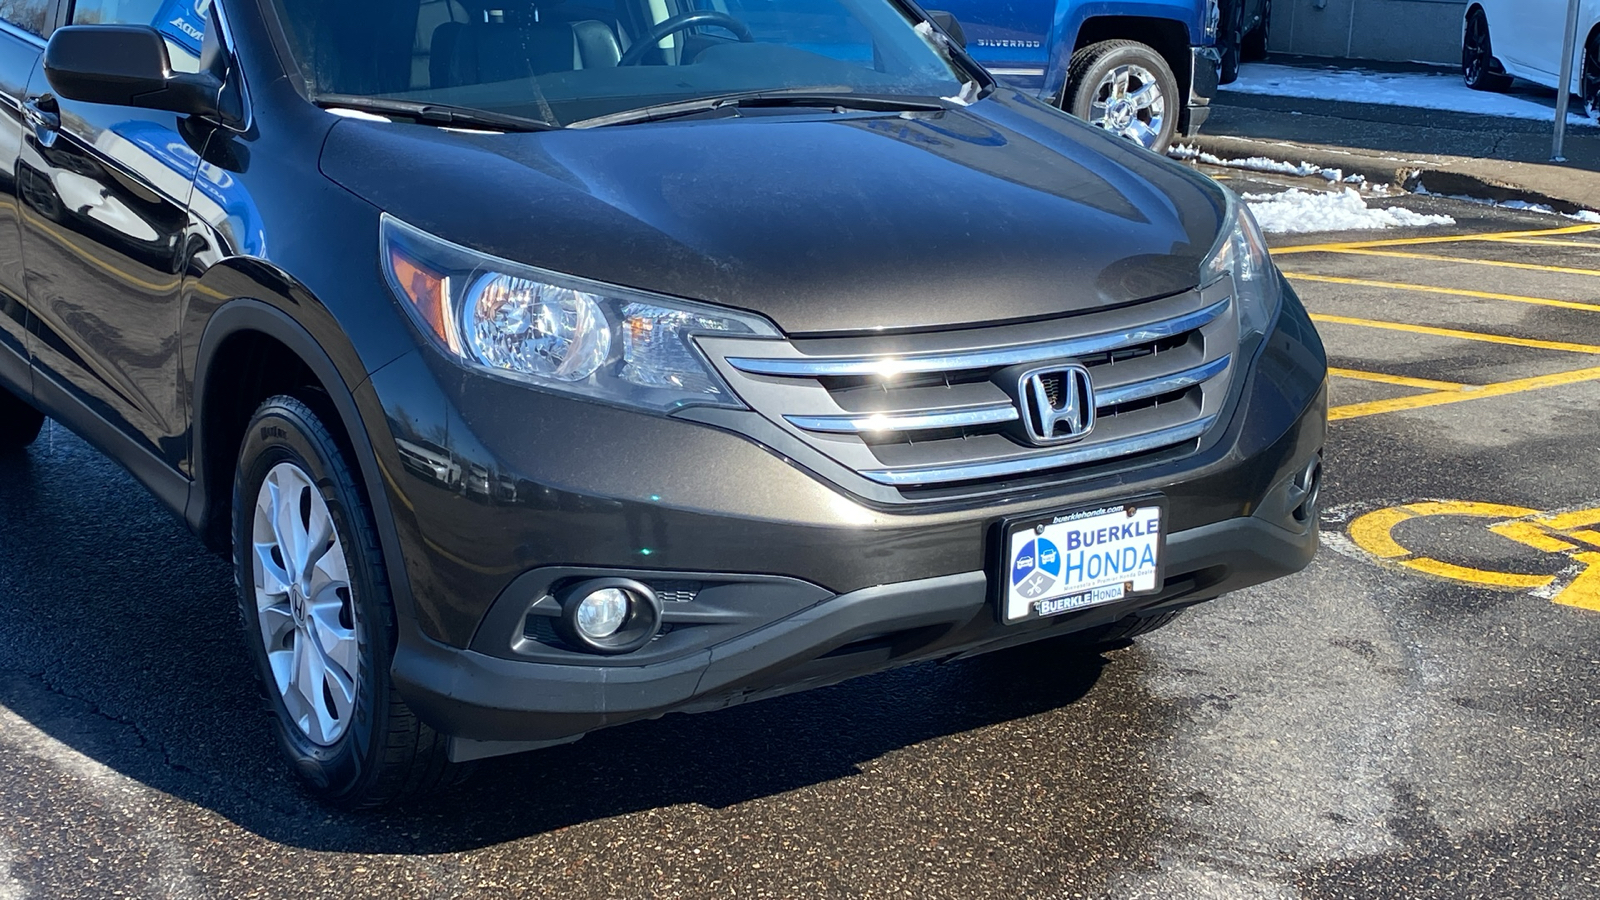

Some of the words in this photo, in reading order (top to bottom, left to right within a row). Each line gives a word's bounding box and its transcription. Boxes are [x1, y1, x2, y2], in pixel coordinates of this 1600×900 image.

[977, 39, 1040, 48] SILVERADO
[1052, 505, 1124, 524] buerklehonda.com
[1066, 518, 1159, 551] BUERKLE
[1065, 543, 1156, 585] HONDA
[1119, 571, 1136, 580] Honda
[1041, 593, 1092, 614] BUERKLE
[1092, 587, 1122, 602] HONDA
